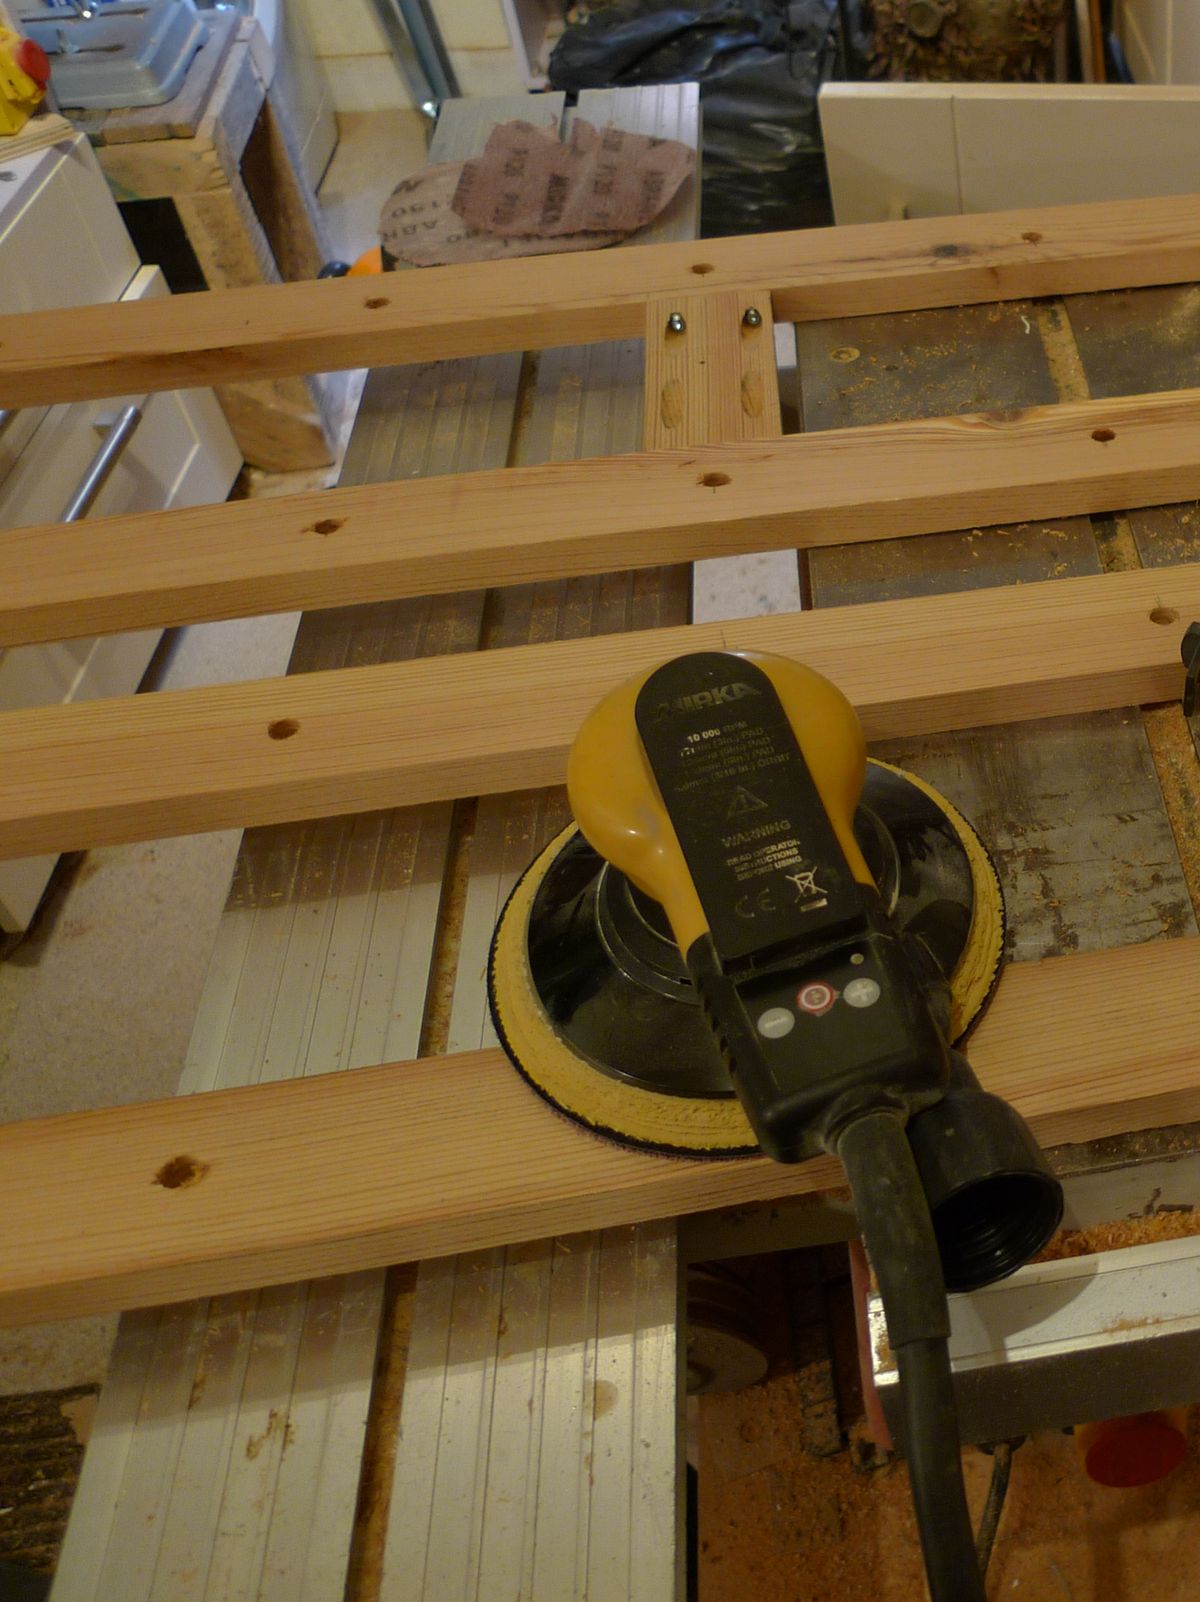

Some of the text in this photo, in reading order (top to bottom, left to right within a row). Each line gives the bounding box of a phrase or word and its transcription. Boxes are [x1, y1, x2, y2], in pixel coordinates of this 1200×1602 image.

[687, 734, 700, 744] 10
[702, 728, 721, 740] 000
[720, 819, 792, 849] WARNING
[774, 855, 803, 871] USING
